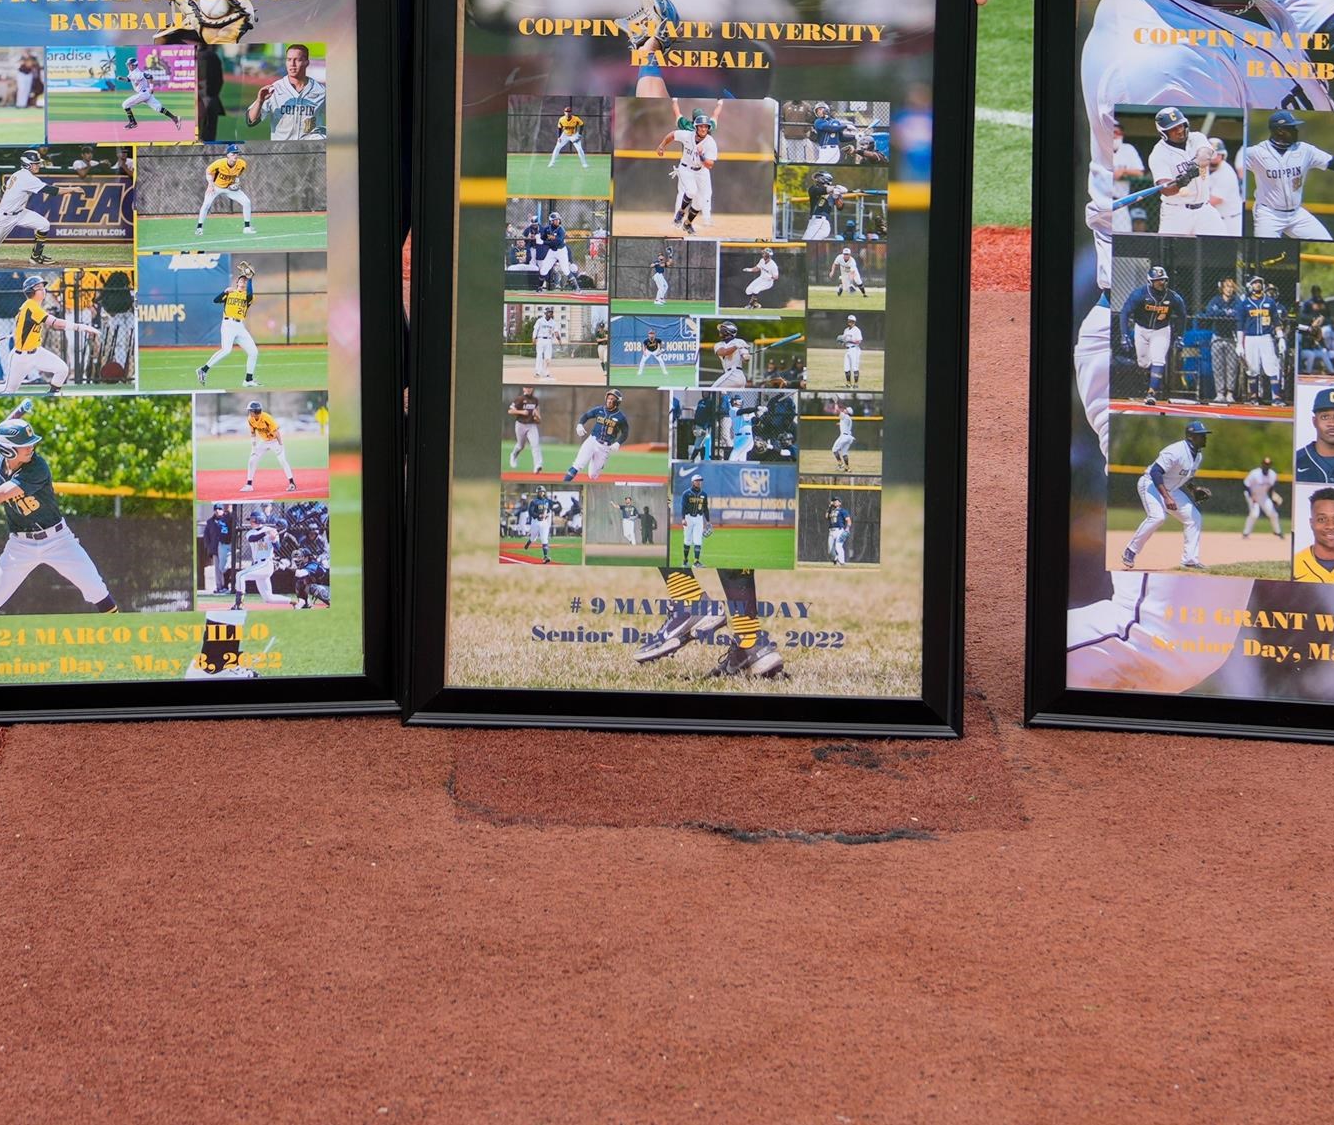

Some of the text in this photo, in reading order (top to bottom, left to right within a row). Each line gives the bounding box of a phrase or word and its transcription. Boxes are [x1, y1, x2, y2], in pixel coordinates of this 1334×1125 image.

[50, 12, 192, 32] BASEBALL
[517, 17, 886, 43] COPPIN STATE UNIVERSITY
[1134, 27, 1235, 47] COPPIN
[1242, 30, 1330, 51] STATE
[47, 49, 92, 61] aradise
[630, 49, 770, 70] BASEBALL
[667, 341, 697, 351] NORTHE
[591, 597, 606, 615] 9
[614, 597, 748, 617] MATTHEW
[756, 600, 813, 619] DAY
[1214, 607, 1308, 633] GRANT
[34, 626, 132, 646] MARCO
[138, 622, 269, 644] CASTILLO
[531, 625, 613, 644] Senior
[786, 631, 844, 649] 2022
[1243, 638, 1302, 663] Day,
[59, 657, 109, 678] Day
[131, 654, 183, 677] May
[223, 651, 283, 671] 2022
